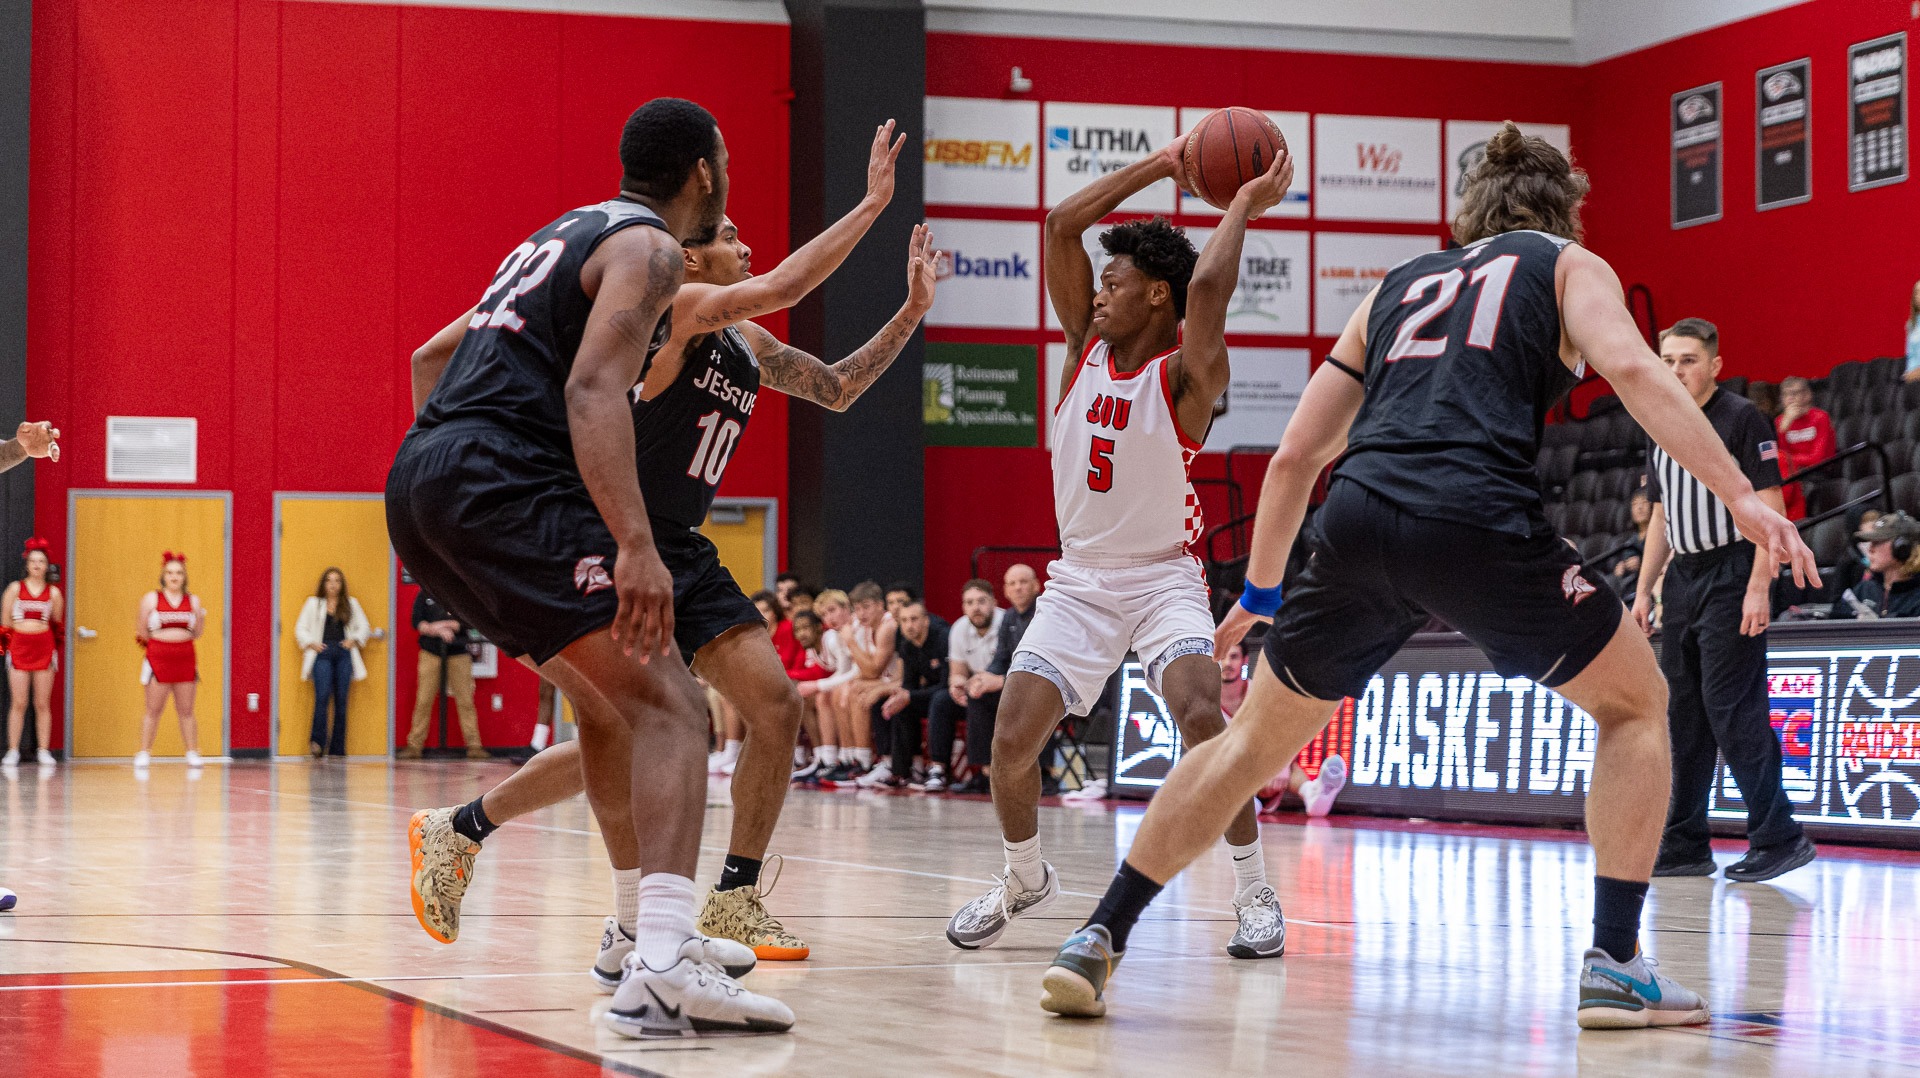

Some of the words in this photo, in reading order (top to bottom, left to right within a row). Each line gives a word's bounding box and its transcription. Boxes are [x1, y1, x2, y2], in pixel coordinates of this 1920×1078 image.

[1072, 127, 1151, 152] LITHIA
[954, 250, 1030, 279] bank
[1247, 256, 1292, 276] TREE
[468, 238, 566, 333] 22
[1385, 254, 1521, 363] 21
[955, 364, 1019, 383] Retirement
[955, 385, 1007, 408] Planning
[1086, 392, 1133, 432] SOU
[687, 409, 741, 486] 10
[1086, 434, 1116, 494] 5
[1351, 671, 1600, 796] BASKETBA
